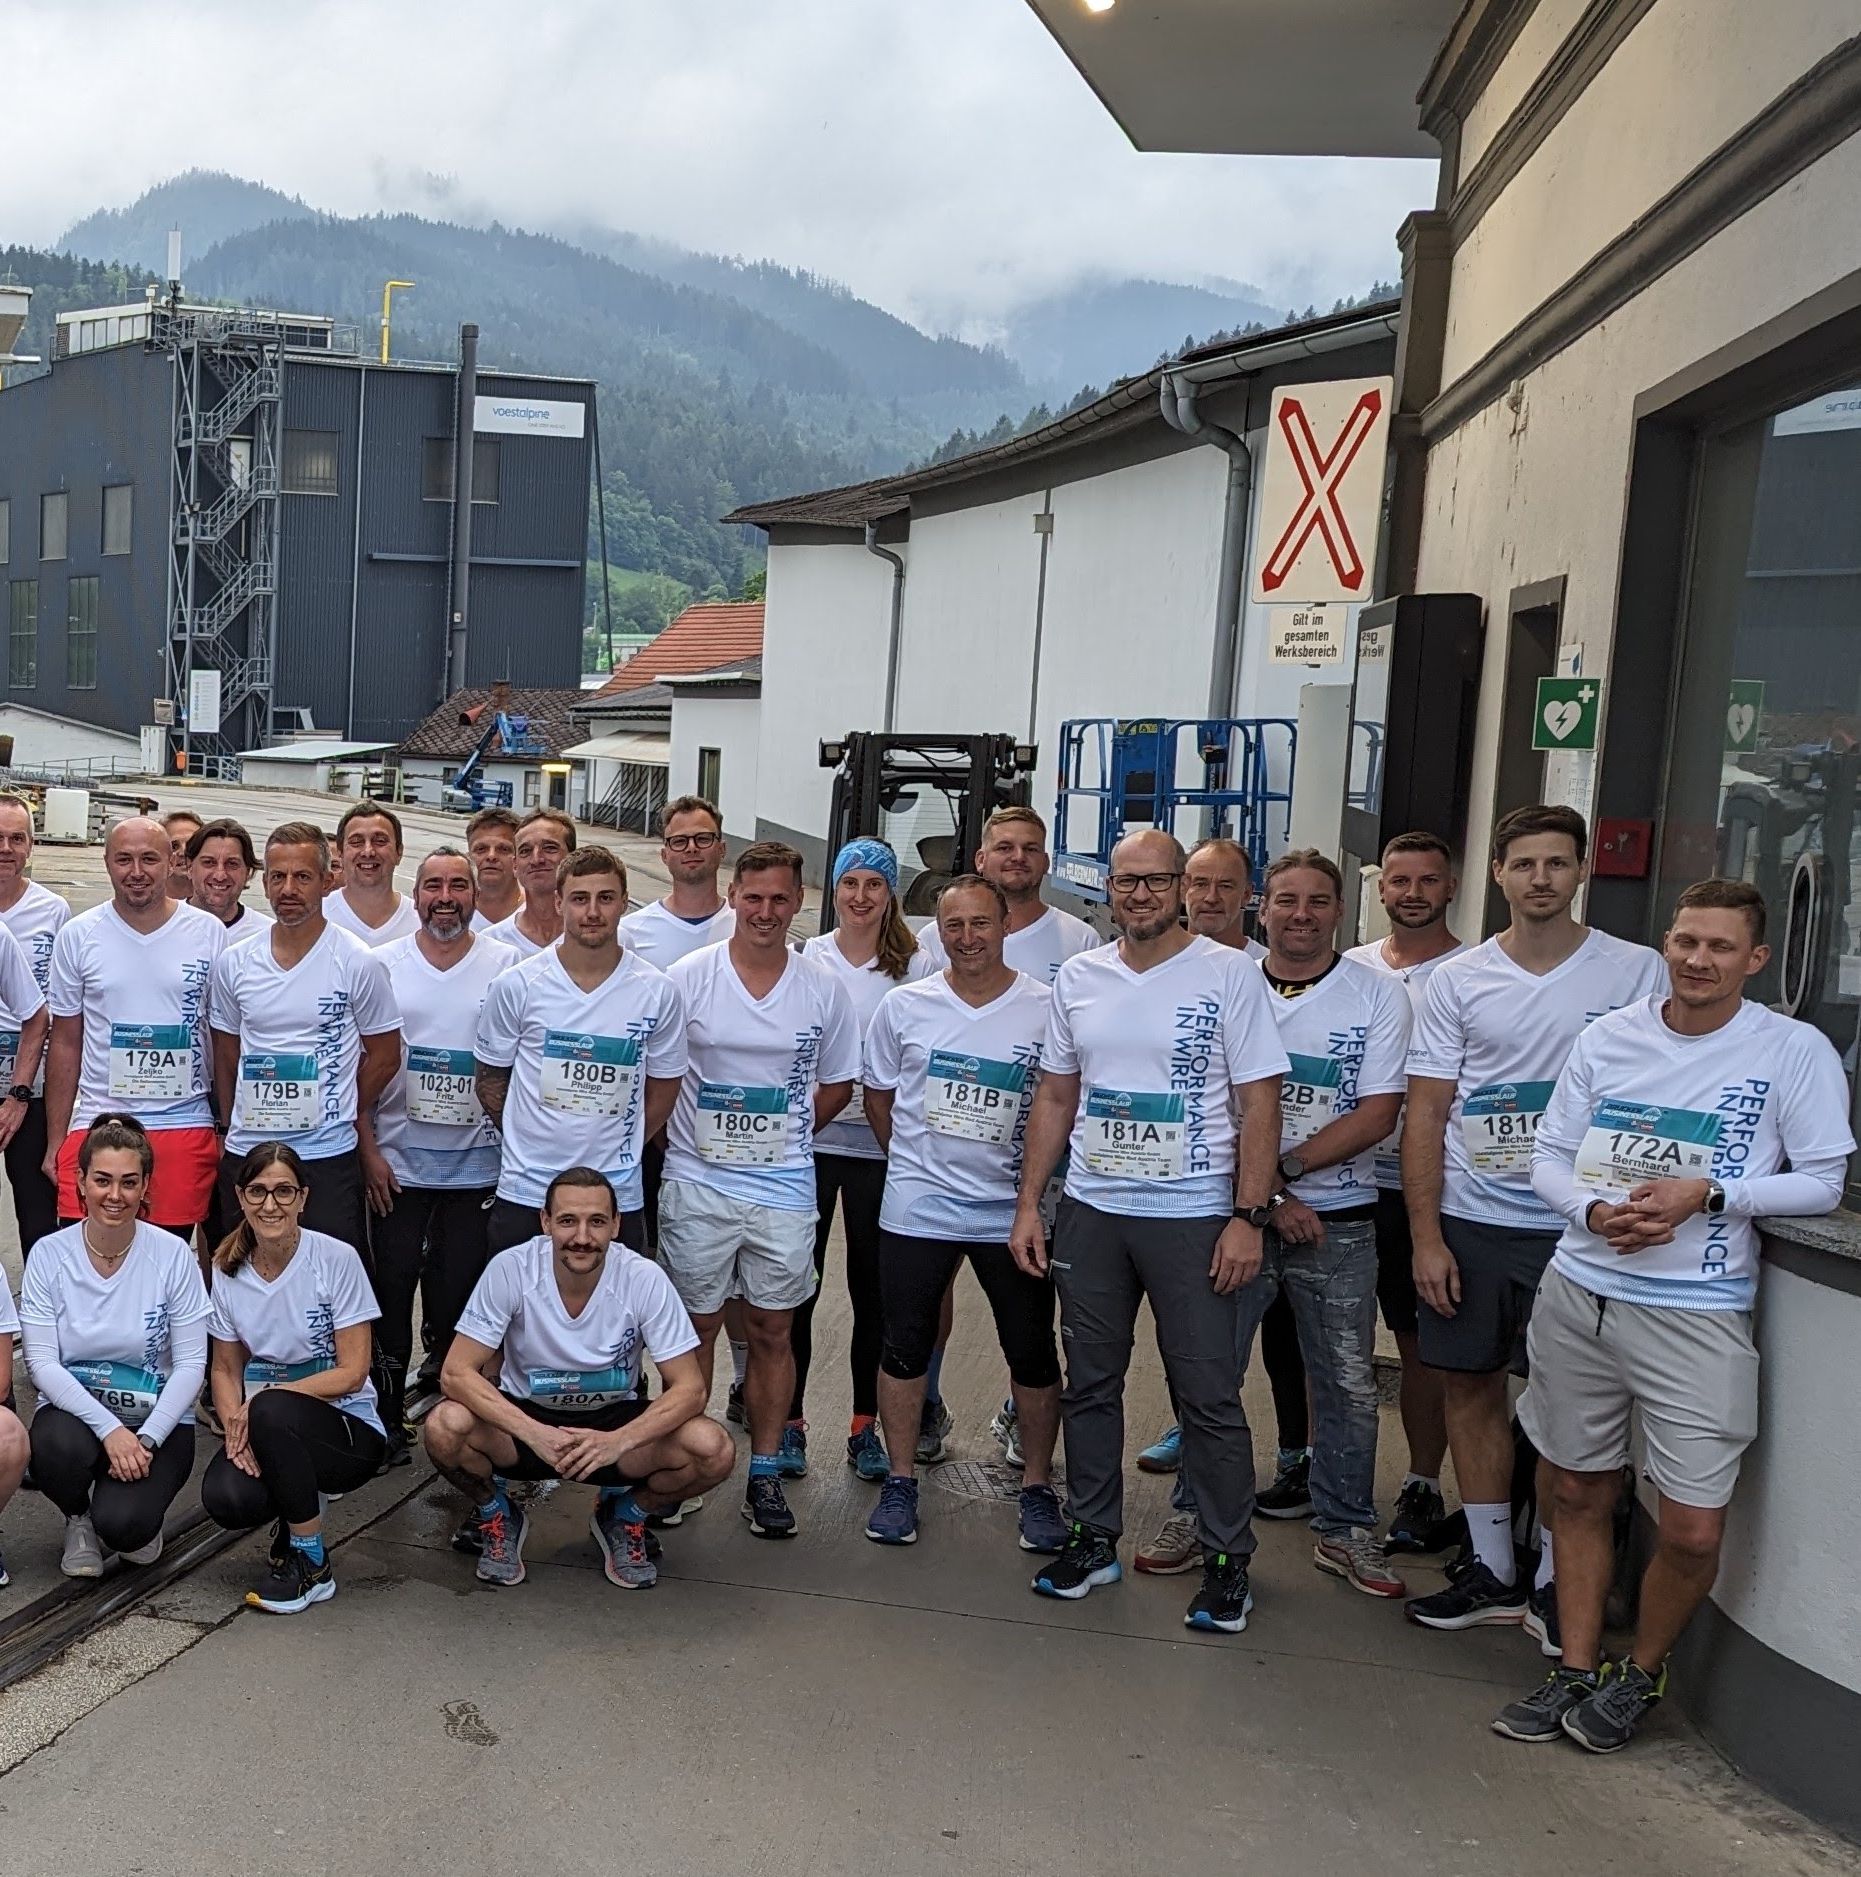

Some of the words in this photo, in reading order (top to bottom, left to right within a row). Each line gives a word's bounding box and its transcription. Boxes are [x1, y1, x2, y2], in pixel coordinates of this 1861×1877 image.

[493, 407, 550, 420] voestalpine
[1292, 613, 1309, 626] Gilt
[1312, 613, 1324, 626] im
[1284, 630, 1329, 645] gesamten
[1275, 644, 1337, 658] Werksbereich
[181, 963, 197, 983] IN
[318, 997, 333, 1016] IN
[1174, 1006, 1197, 1030] IN
[1327, 1031, 1349, 1056] IN
[125, 1050, 176, 1067] 179A
[325, 991, 349, 1121] PERFORMANCE
[1170, 1036, 1192, 1091] WIRE
[137, 1068, 163, 1076] Zeljko
[560, 1061, 616, 1084] 180B
[252, 1082, 300, 1100] 179B
[419, 1073, 473, 1095] 1023-01
[570, 1080, 603, 1091] Philipp
[1188, 1000, 1220, 1174] PERFORMANCE
[436, 1092, 455, 1101] Fritz
[943, 1081, 1001, 1108] 181B
[1714, 1085, 1743, 1112] IN
[950, 1100, 987, 1114] Michael
[1601, 1108, 1663, 1122] BUSINESSLAUF
[1604, 1102, 1643, 1114] BRUCKER
[712, 1112, 769, 1133] 180C
[1100, 1119, 1161, 1143] 181A
[725, 1131, 754, 1140] Martin
[1497, 1135, 1536, 1144] Michae
[1111, 1140, 1146, 1151] Gunter
[1609, 1132, 1683, 1166] 172A
[1611, 1152, 1671, 1173] Bernhard
[1701, 1078, 1771, 1275] PERFORNCE
[144, 1311, 157, 1331] IN
[306, 1310, 320, 1329] IN
[534, 1377, 581, 1385] BUSINESSLAUF
[85, 1387, 136, 1409] 76B
[549, 1393, 607, 1405] 180A
